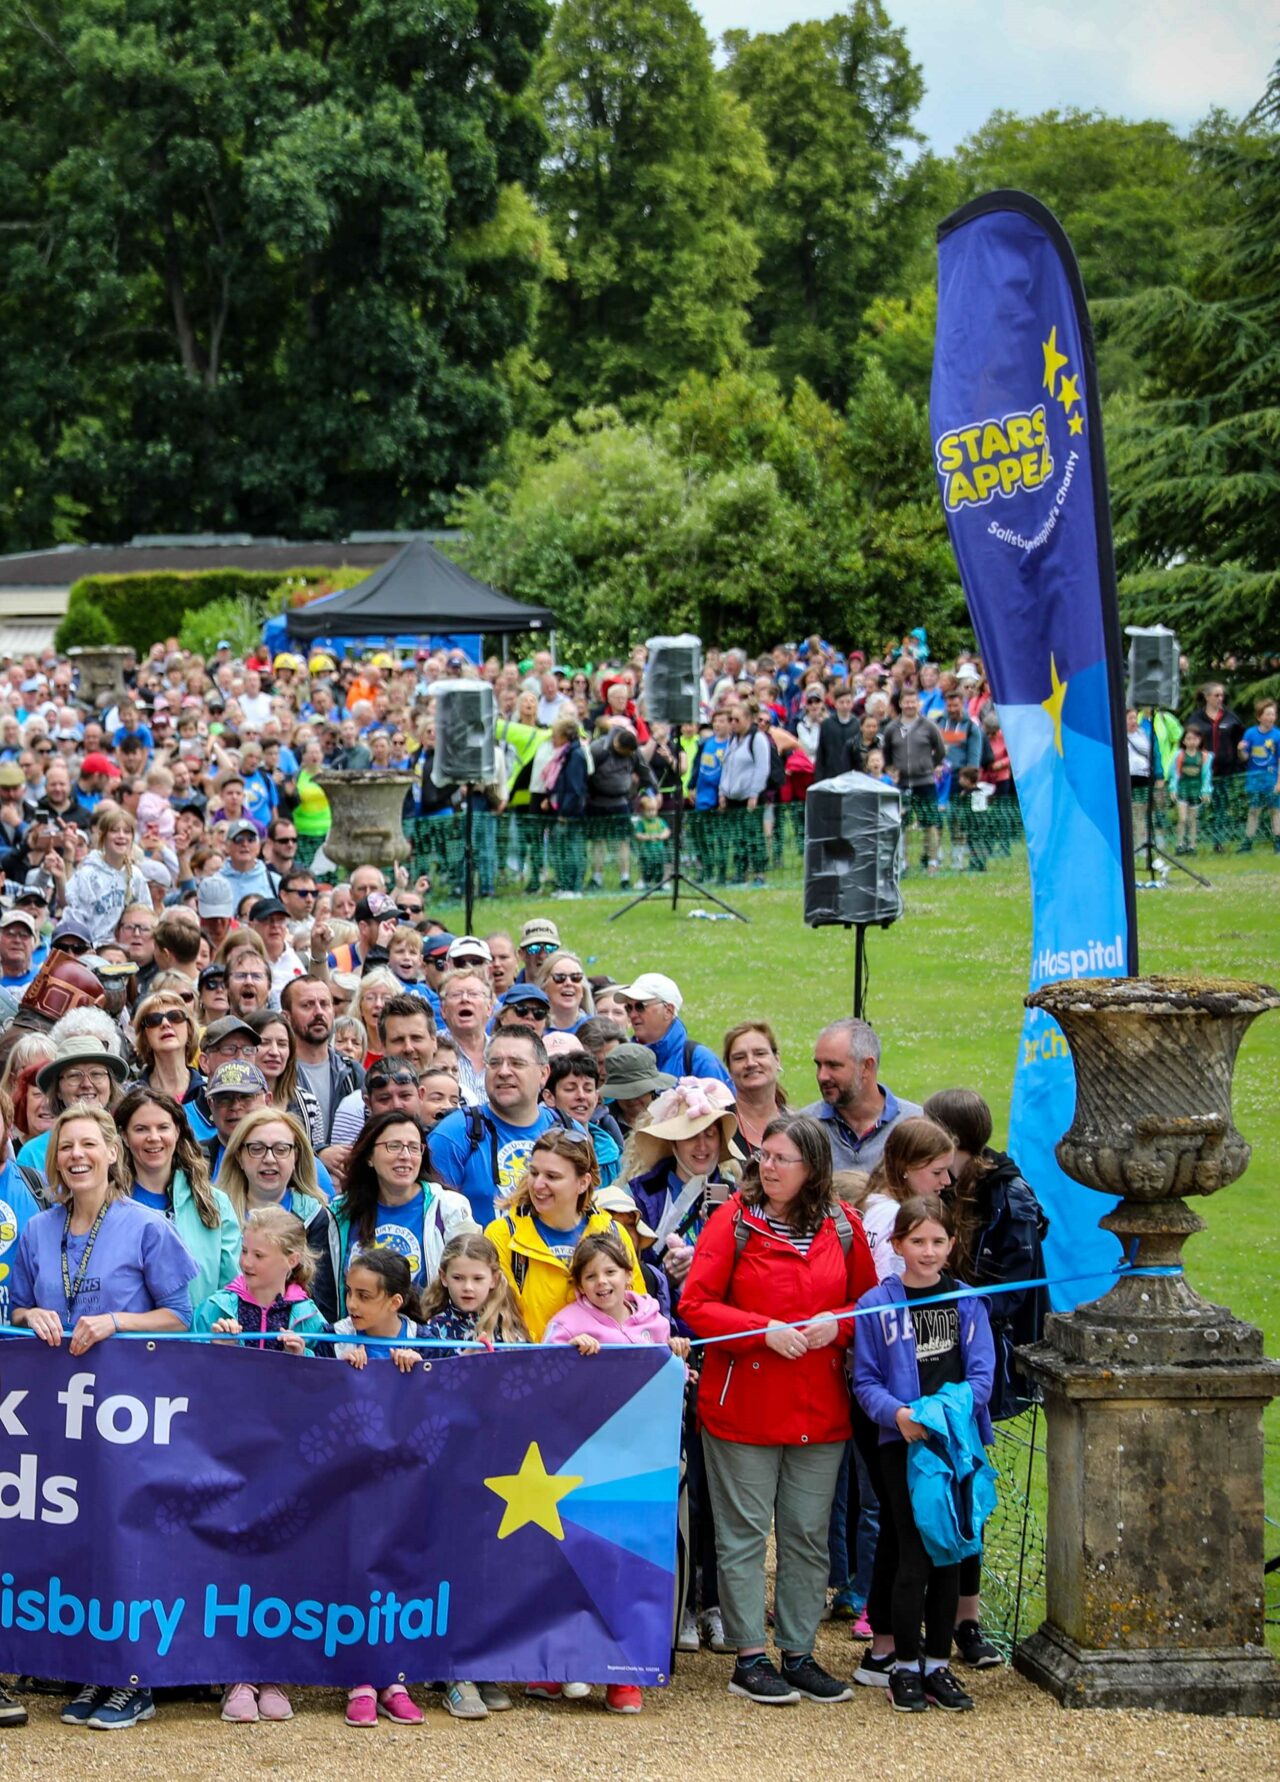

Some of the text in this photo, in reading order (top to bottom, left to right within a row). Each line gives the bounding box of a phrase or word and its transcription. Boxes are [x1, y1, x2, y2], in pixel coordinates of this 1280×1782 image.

[940, 409, 1046, 471] STARS
[1055, 450, 1080, 506] Charity
[1038, 935, 1124, 979] Hospital
[57, 1372, 189, 1445] for
[203, 1580, 451, 1658] Hospital
